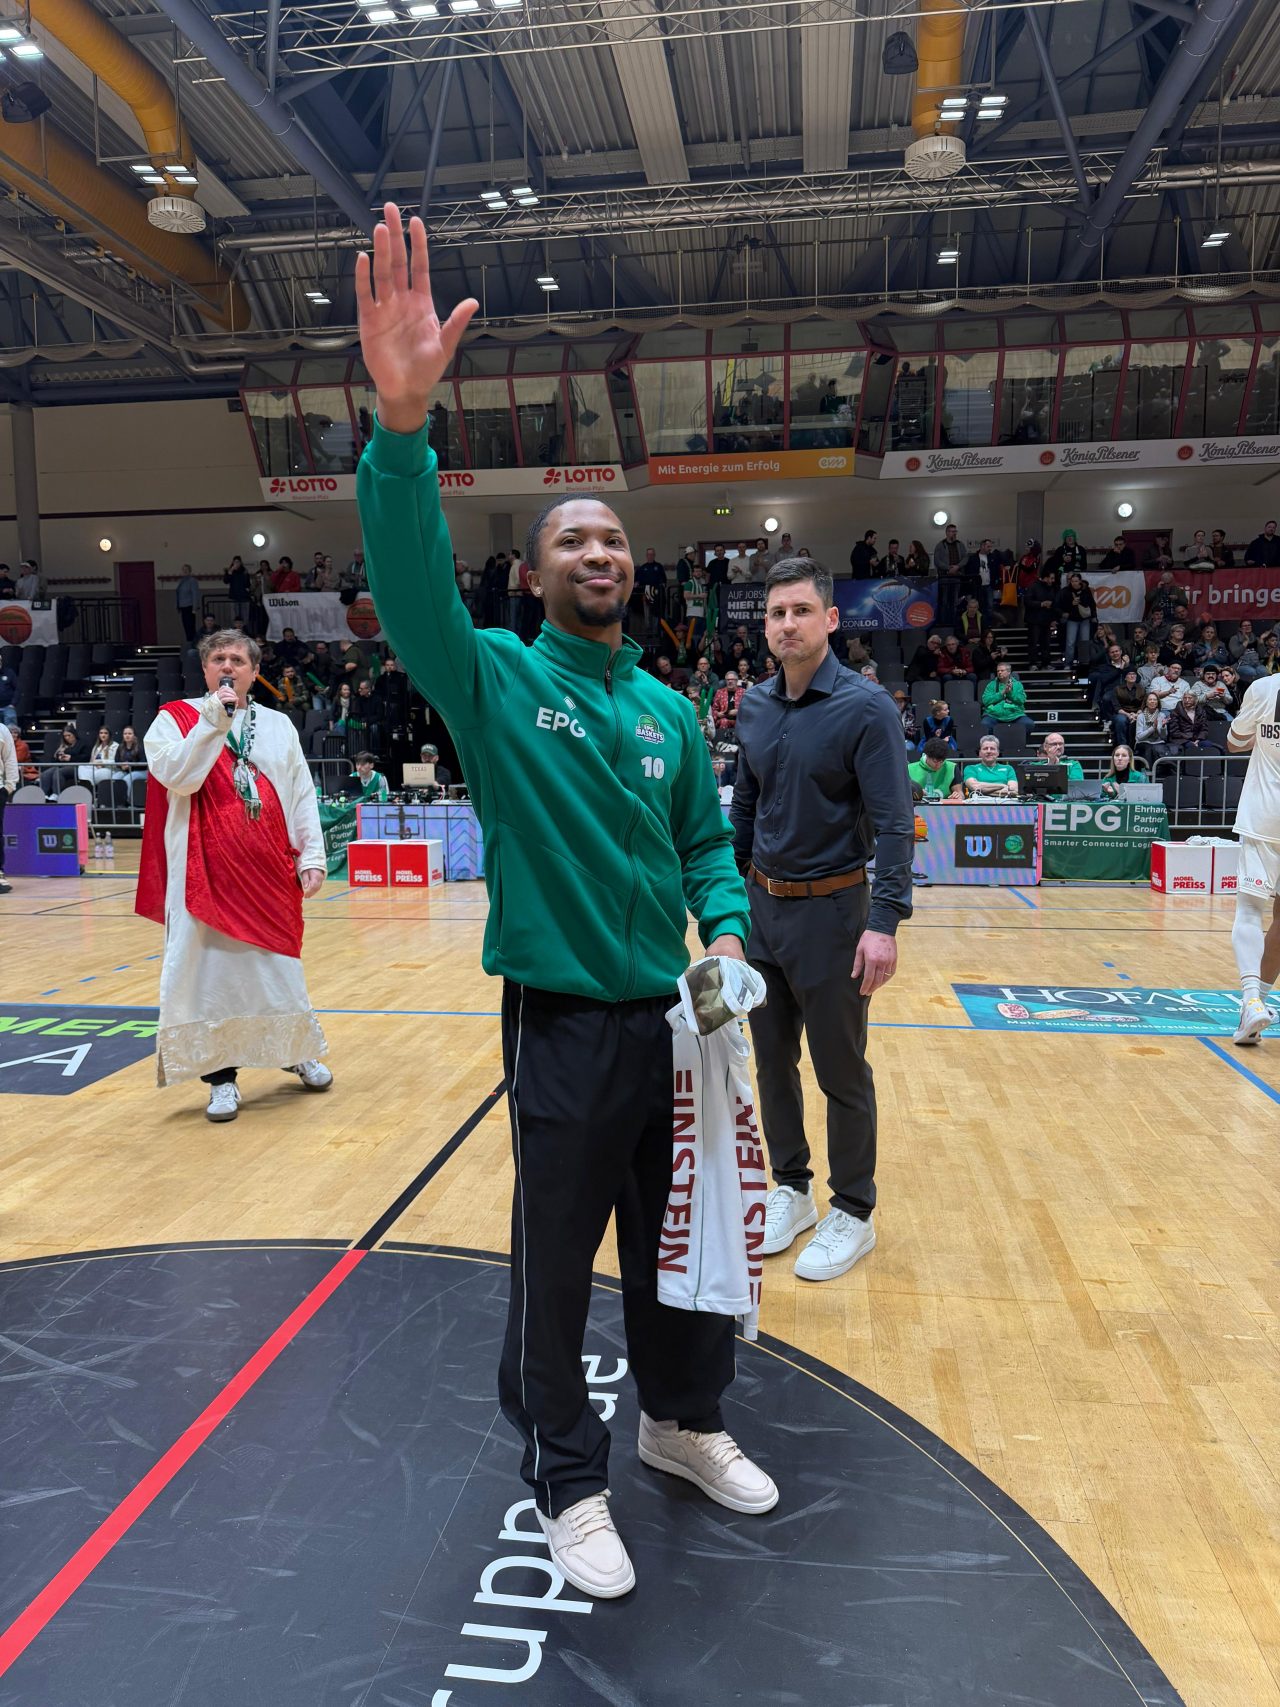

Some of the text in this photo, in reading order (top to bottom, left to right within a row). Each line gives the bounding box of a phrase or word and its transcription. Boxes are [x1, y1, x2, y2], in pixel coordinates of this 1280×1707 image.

[926, 452, 1003, 472] König Pilsener
[1060, 446, 1140, 466] König Pilsener
[658, 460, 780, 475] Mit Energie zum Erfolg
[438, 473, 474, 487] OTTO
[565, 468, 616, 483] LOTTO
[289, 478, 337, 492] LOTTO
[728, 590, 743, 600] AUF
[1180, 585, 1202, 605] ir
[269, 598, 299, 607] Wilson
[728, 601, 755, 610] HIER
[727, 611, 750, 620] WIR
[842, 619, 878, 628] CONLOG
[536, 706, 586, 738] EPG
[641, 756, 664, 779] 10
[1045, 803, 1121, 831] EPG
[1134, 815, 1164, 823] Partner
[1082, 840, 1128, 848] Connected
[354, 874, 382, 882] PREISS
[395, 874, 422, 882] PREISS
[1173, 881, 1205, 889] PREISS
